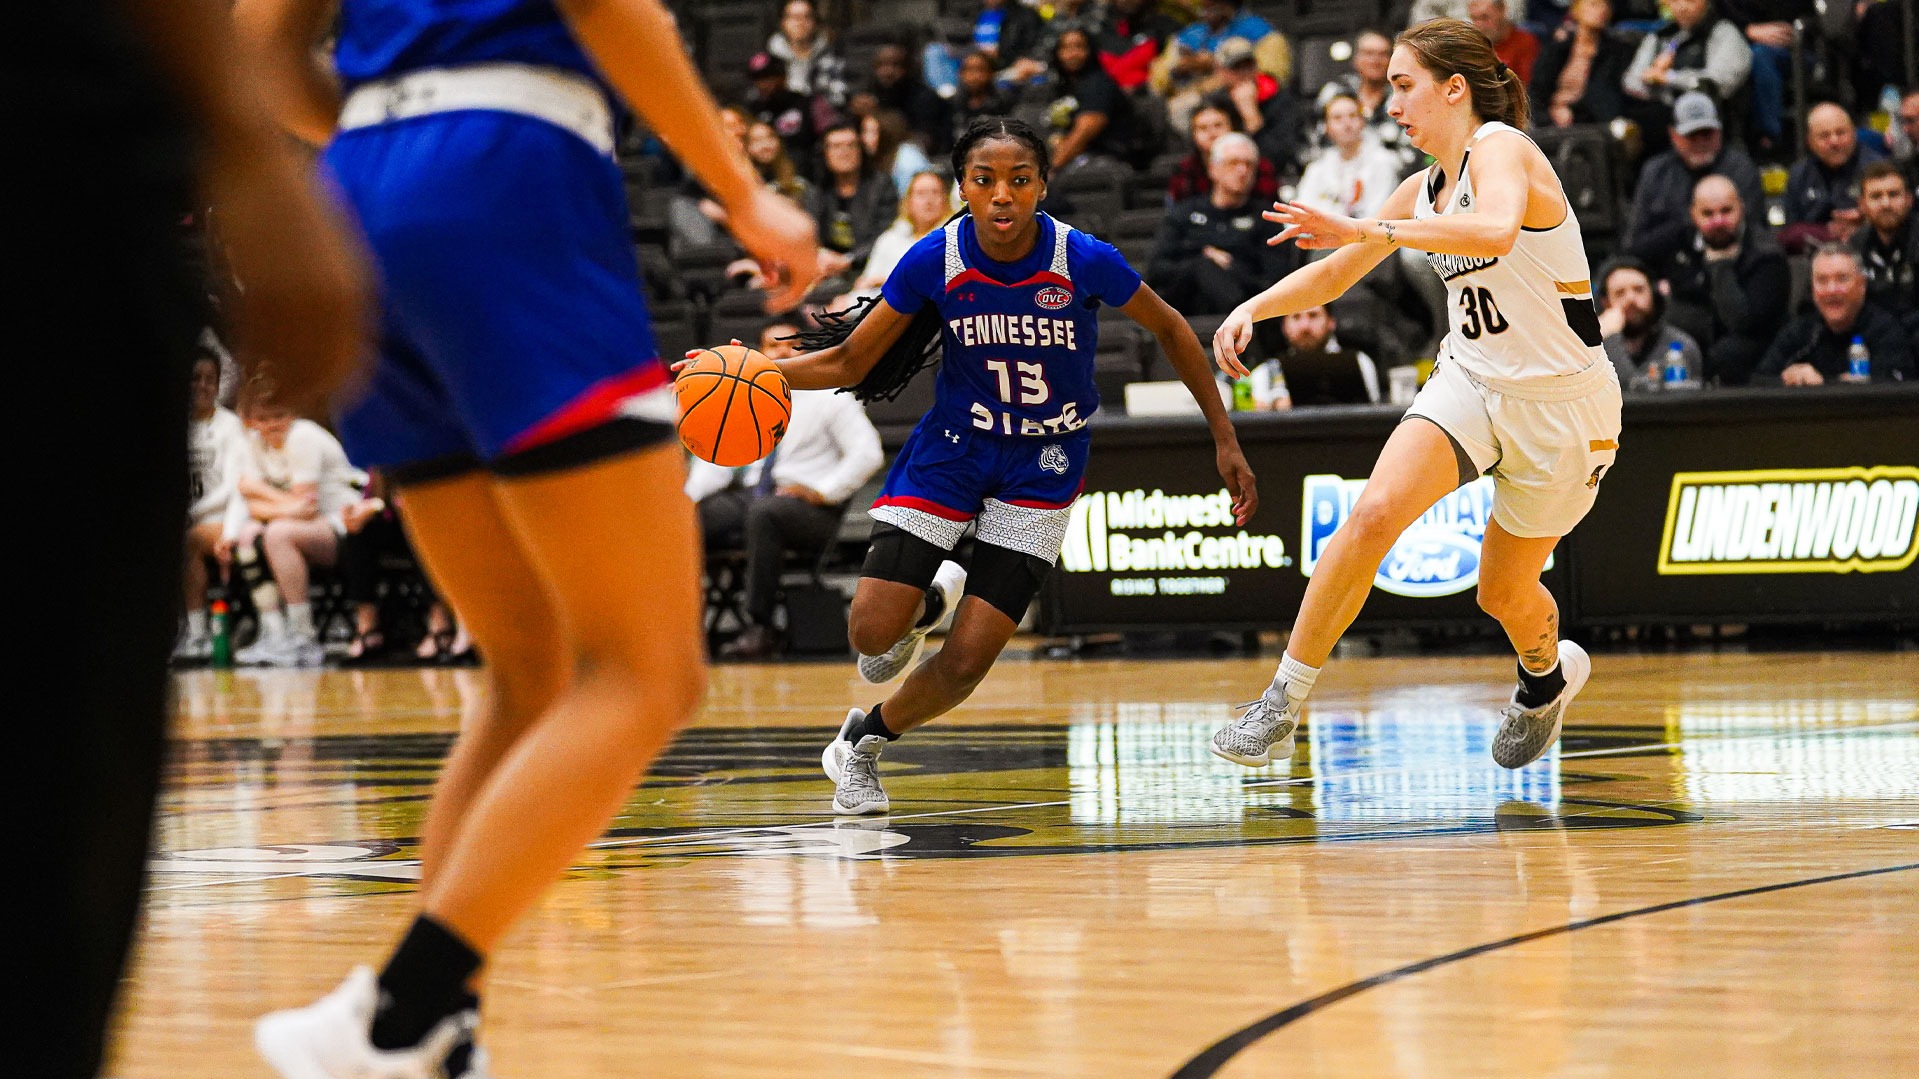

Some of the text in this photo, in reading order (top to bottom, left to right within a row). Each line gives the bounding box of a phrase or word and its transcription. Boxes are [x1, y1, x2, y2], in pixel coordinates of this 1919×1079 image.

[1042, 294, 1064, 303] OVC
[1459, 286, 1510, 340] 30
[950, 314, 1077, 350] TENNESSEE
[987, 359, 1049, 405] 13
[1106, 488, 1235, 529] Midwest
[1671, 479, 1919, 561] LINDENWOOD
[1388, 541, 1460, 582] Ford
